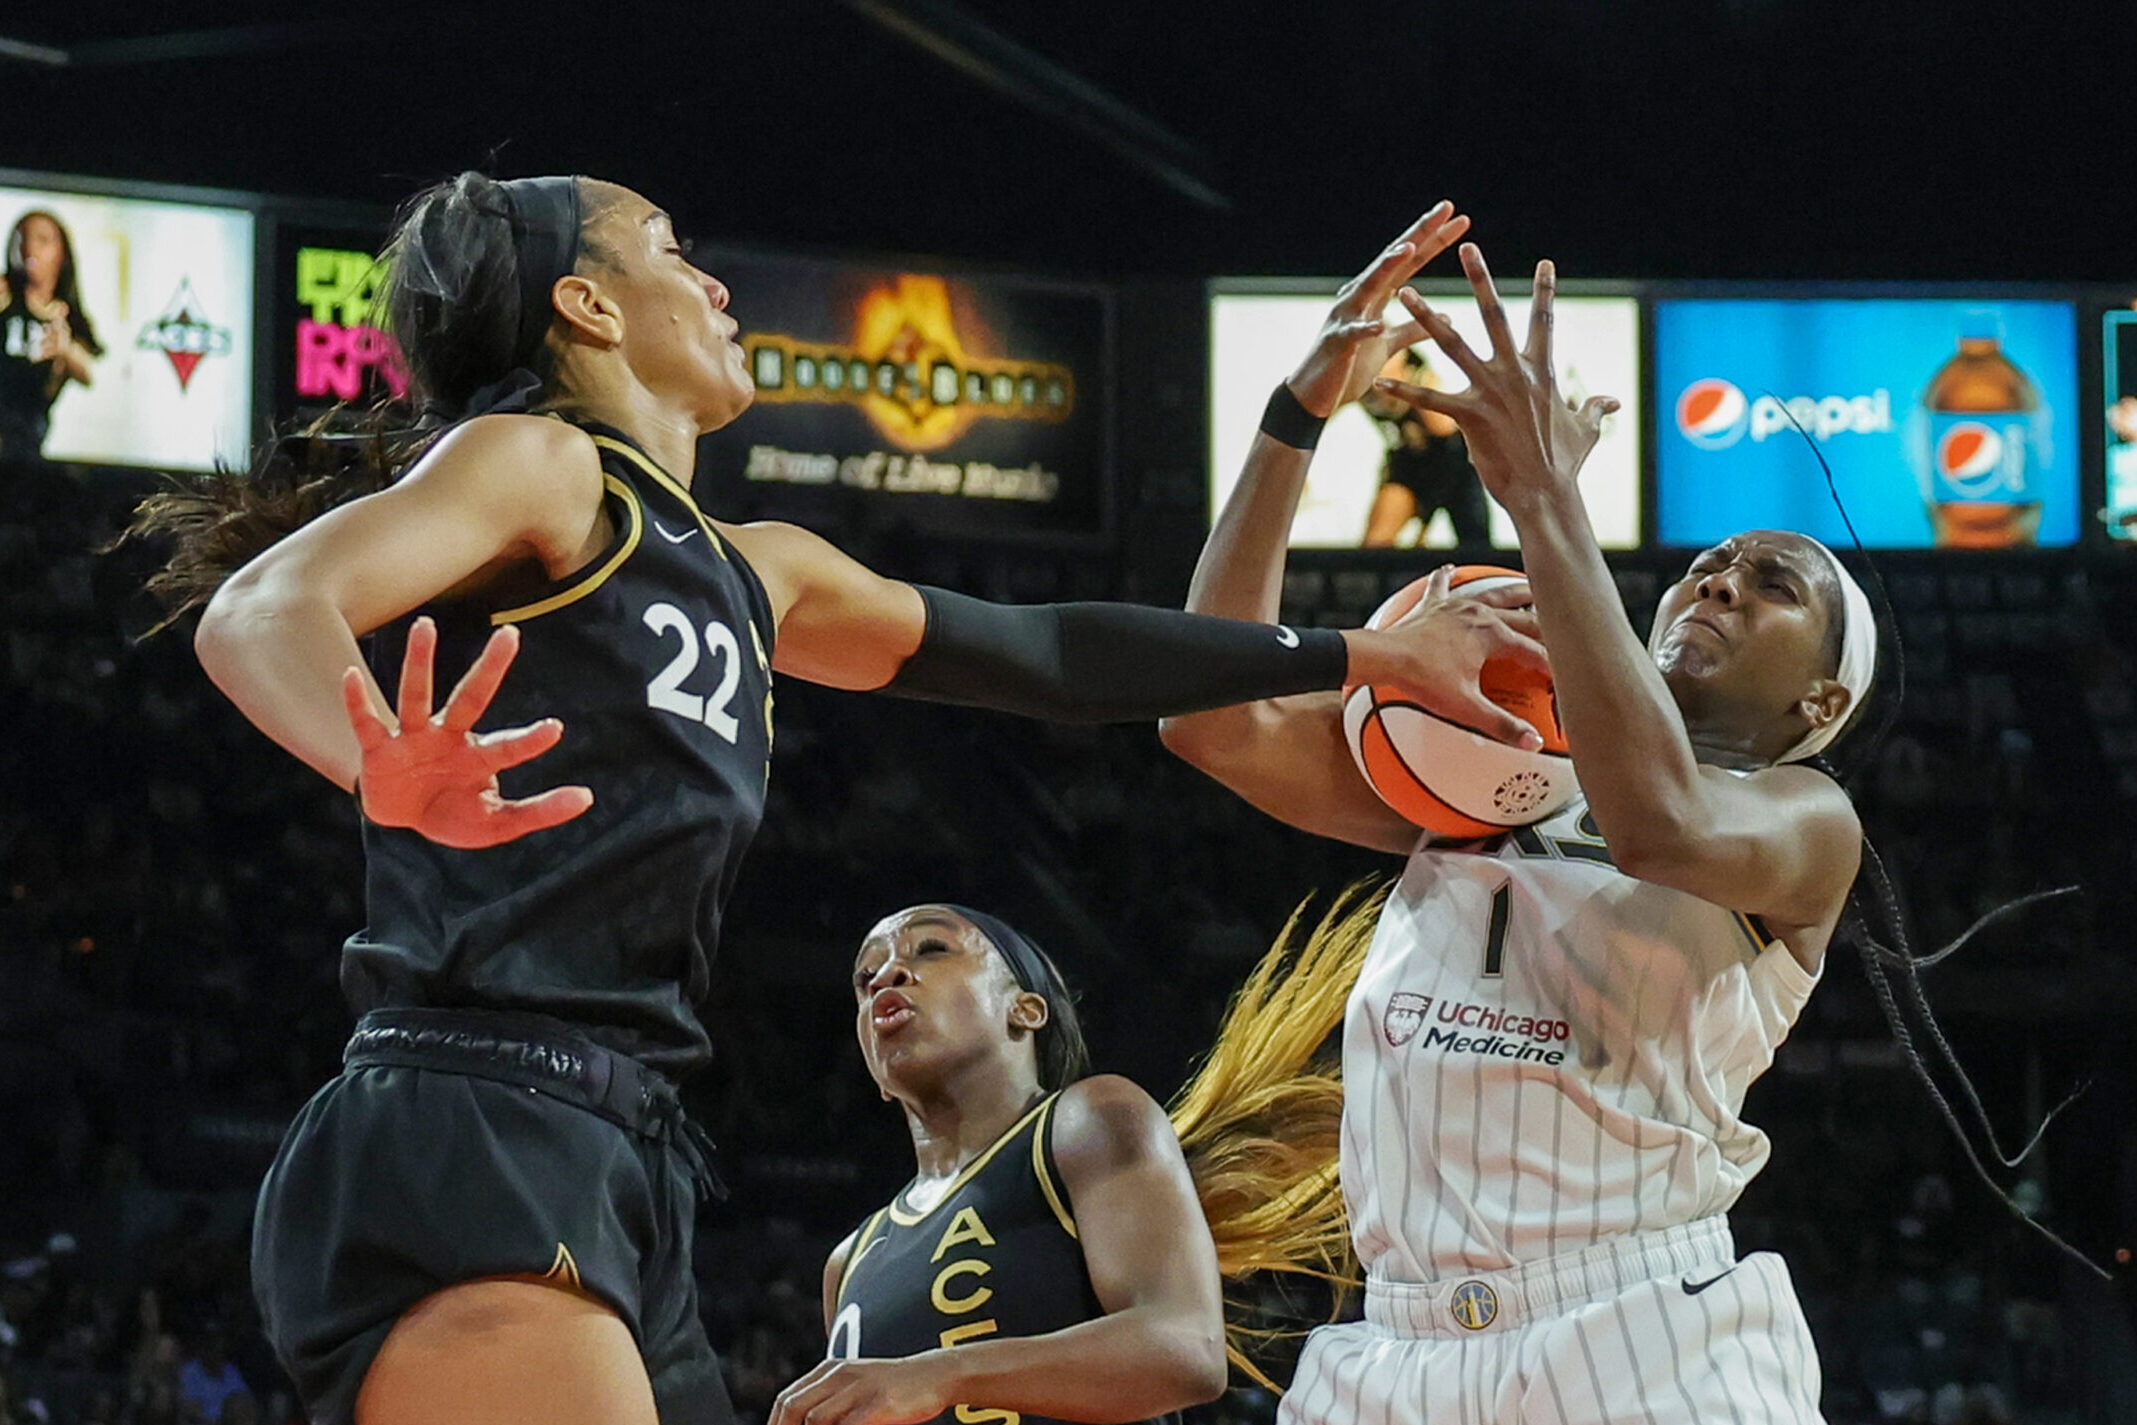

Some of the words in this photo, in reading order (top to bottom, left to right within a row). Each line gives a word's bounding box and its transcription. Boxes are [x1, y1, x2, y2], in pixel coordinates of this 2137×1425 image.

[1750, 389, 1891, 442] pepsi
[642, 602, 741, 745] 22
[1481, 876, 1513, 979] 1
[1422, 1027, 1565, 1066] Medicine
[1436, 1000, 1570, 1043] UChicago
